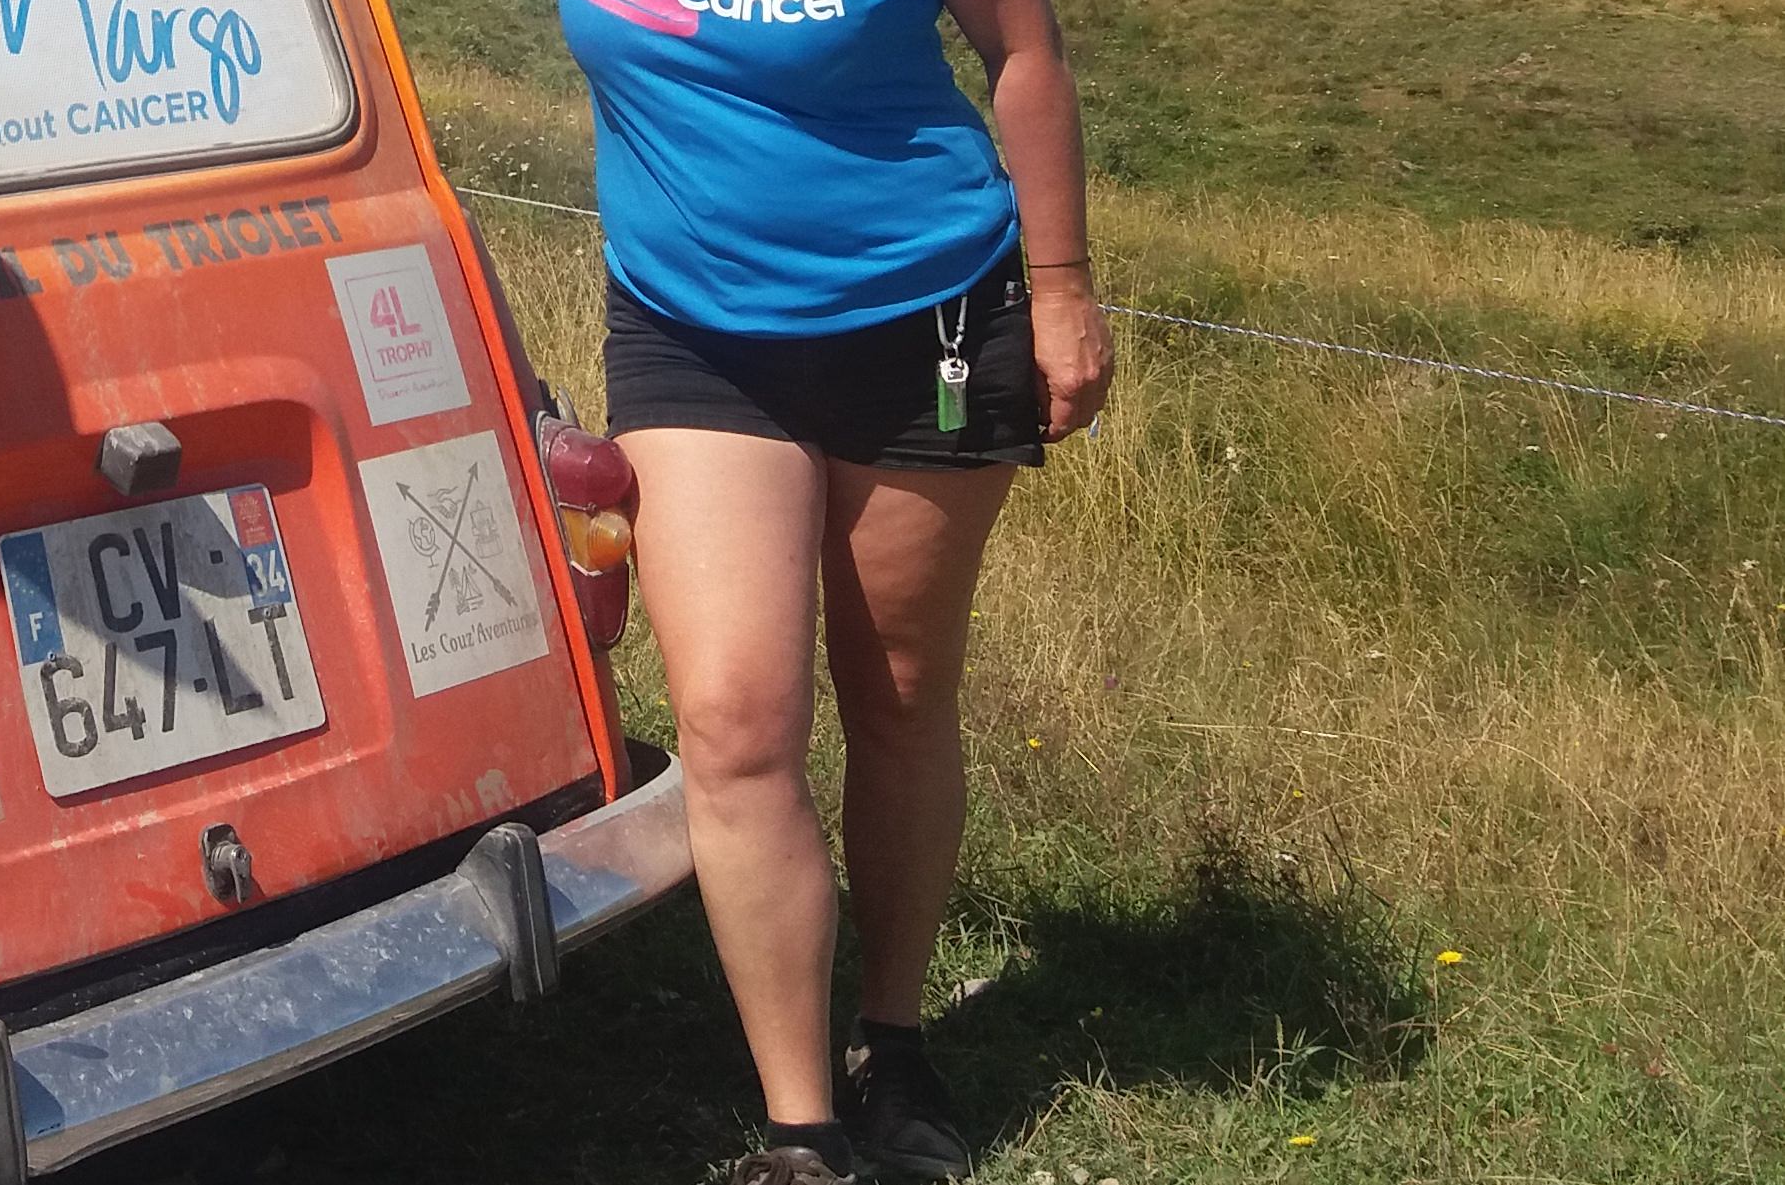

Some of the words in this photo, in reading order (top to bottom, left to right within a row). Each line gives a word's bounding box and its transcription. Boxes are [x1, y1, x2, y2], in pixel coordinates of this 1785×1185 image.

[66, 91, 210, 135] CANCER
[51, 232, 133, 286] DU
[142, 196, 344, 271] TRIOLET
[369, 286, 423, 337] 4L
[29, 612, 43, 642] F
[411, 642, 436, 664] Les
